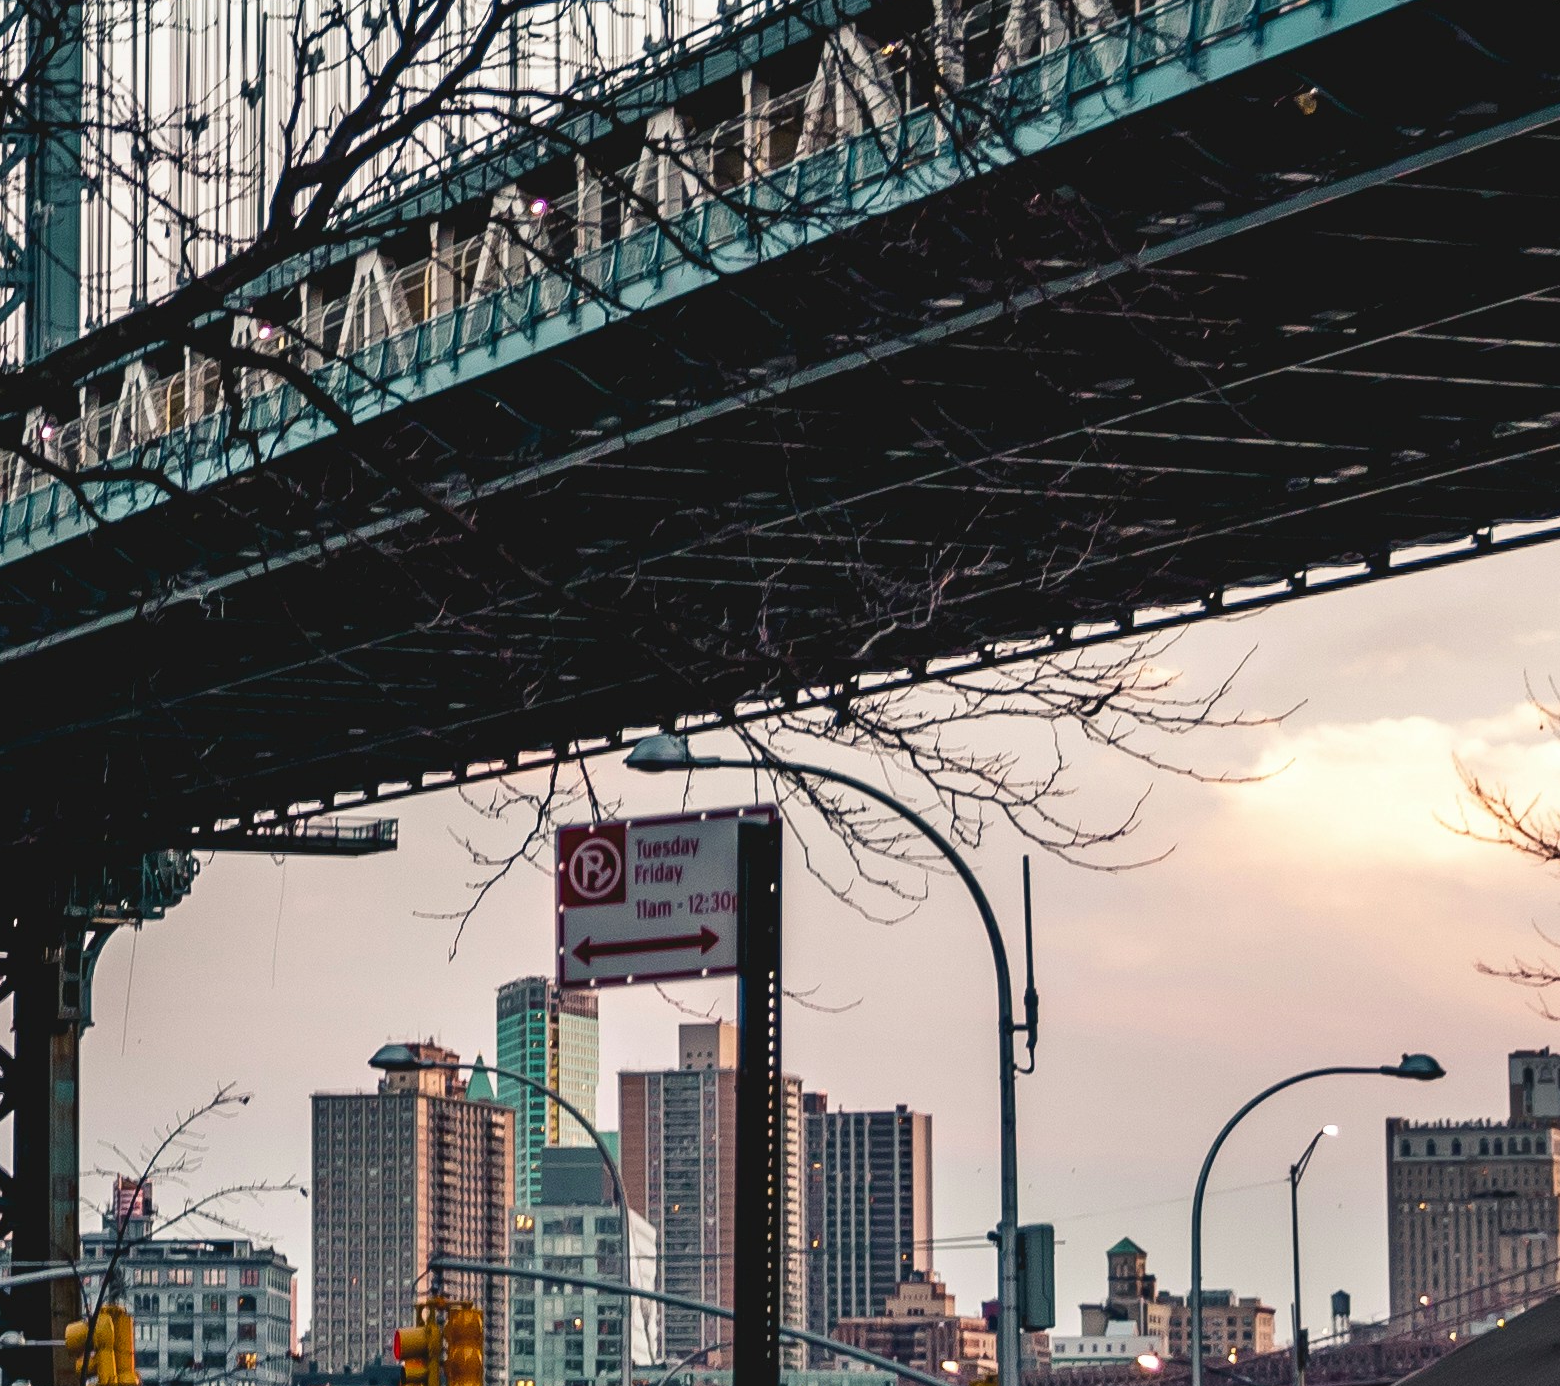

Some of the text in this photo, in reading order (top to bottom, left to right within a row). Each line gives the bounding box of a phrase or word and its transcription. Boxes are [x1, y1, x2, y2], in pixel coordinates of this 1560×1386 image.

[636, 835, 700, 860] Tuesday
[635, 862, 683, 886] Friday
[636, 898, 672, 919] 11am
[689, 891, 738, 915] 12:30p
